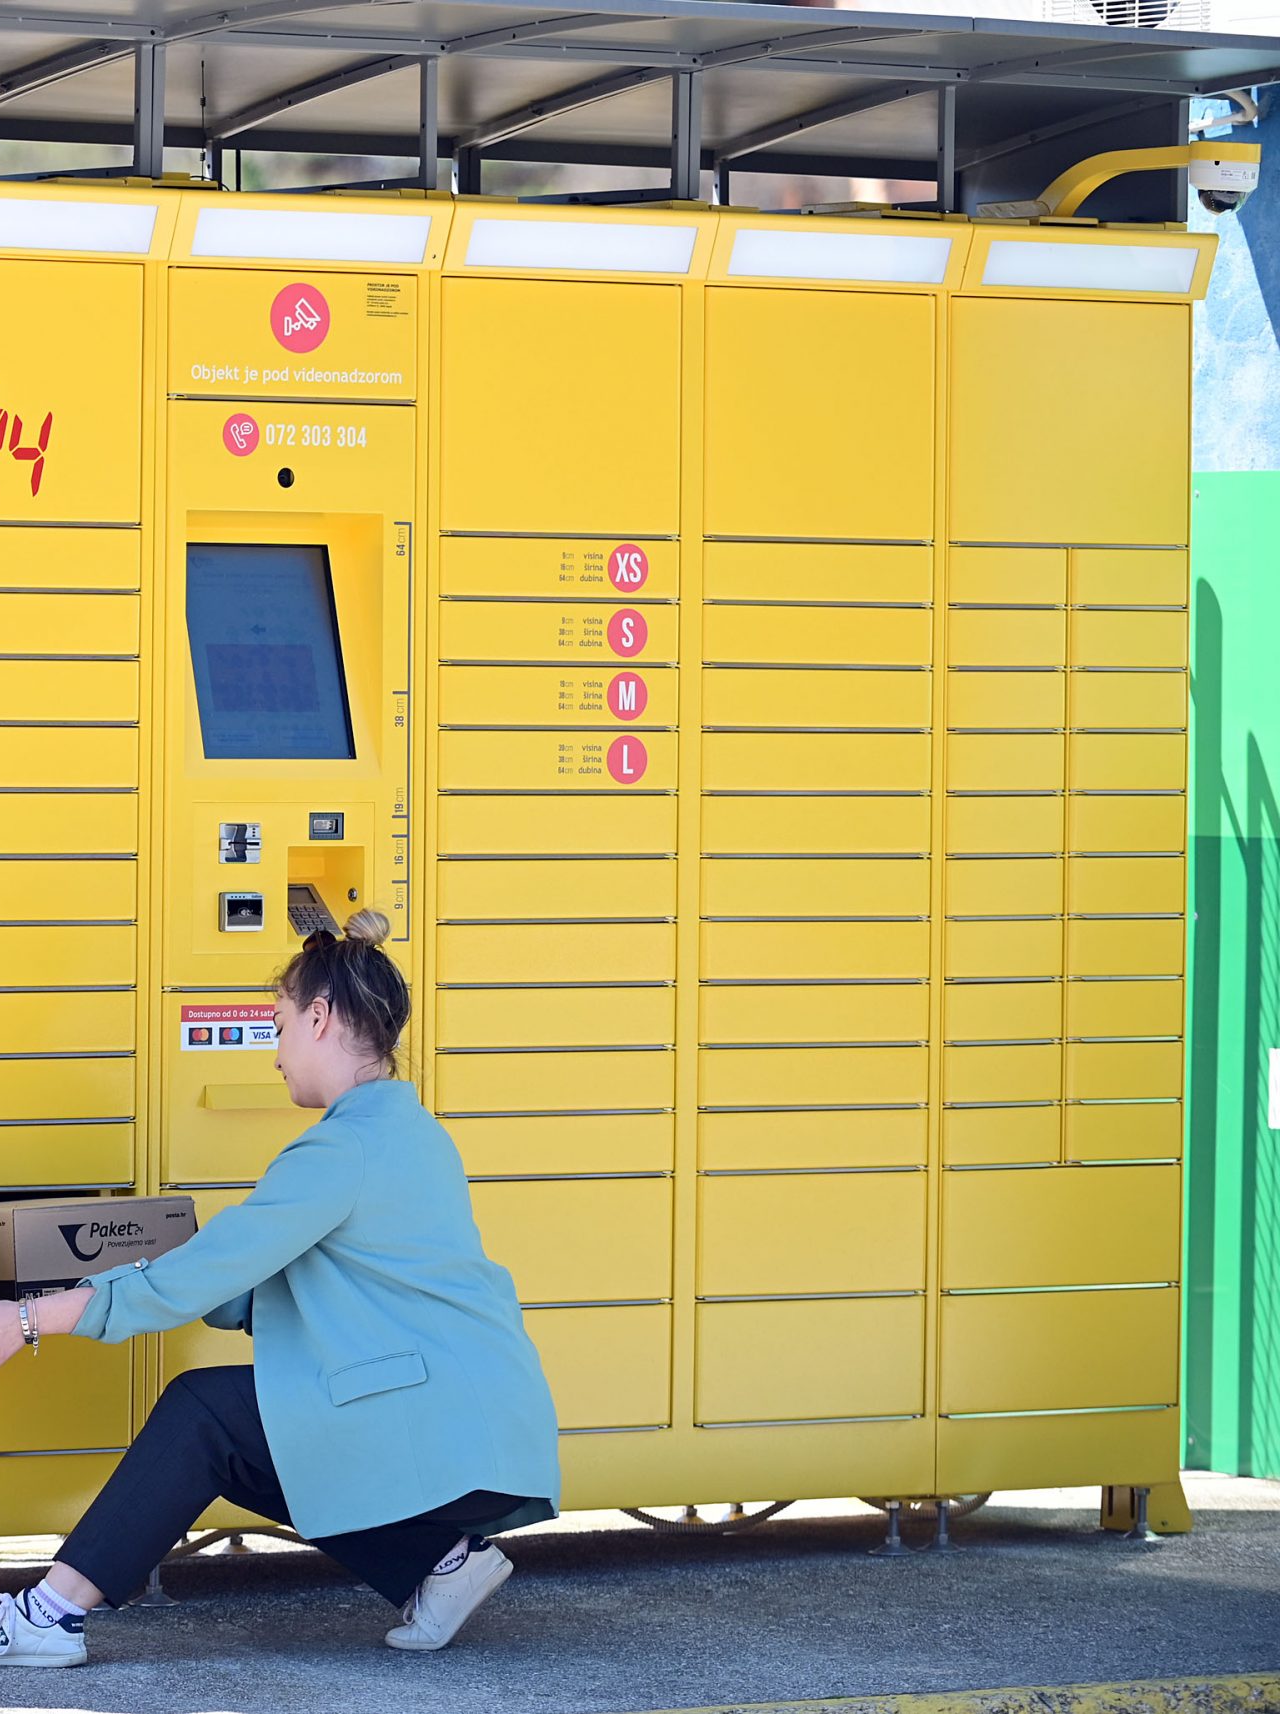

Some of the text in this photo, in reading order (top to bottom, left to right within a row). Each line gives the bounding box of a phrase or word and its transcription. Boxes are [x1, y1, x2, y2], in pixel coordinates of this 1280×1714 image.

[191, 365, 403, 385] Objekt je pod videonadzorom
[265, 424, 367, 448] 072 303 304
[396, 544, 405, 556] 64
[615, 552, 642, 583] XS
[580, 574, 603, 582] dubina
[583, 616, 602, 624] visina
[621, 617, 634, 648] S
[579, 639, 602, 647] dubina
[583, 680, 602, 688] visina
[619, 681, 635, 711] M
[579, 702, 602, 710] dubina
[395, 715, 404, 727] 38
[623, 744, 634, 774] L
[578, 766, 602, 774] dubina
[395, 803, 403, 813] 19
[394, 855, 403, 864] 16
[188, 1009, 220, 1019] Dostupno
[222, 1009, 231, 1018] od
[233, 1010, 238, 1018] 0
[240, 1009, 248, 1018] do
[260, 1009, 275, 1017] sata
[253, 1031, 271, 1040] VISA
[89, 1220, 138, 1238] Paket
[107, 1240, 143, 1248] Povezujemo
